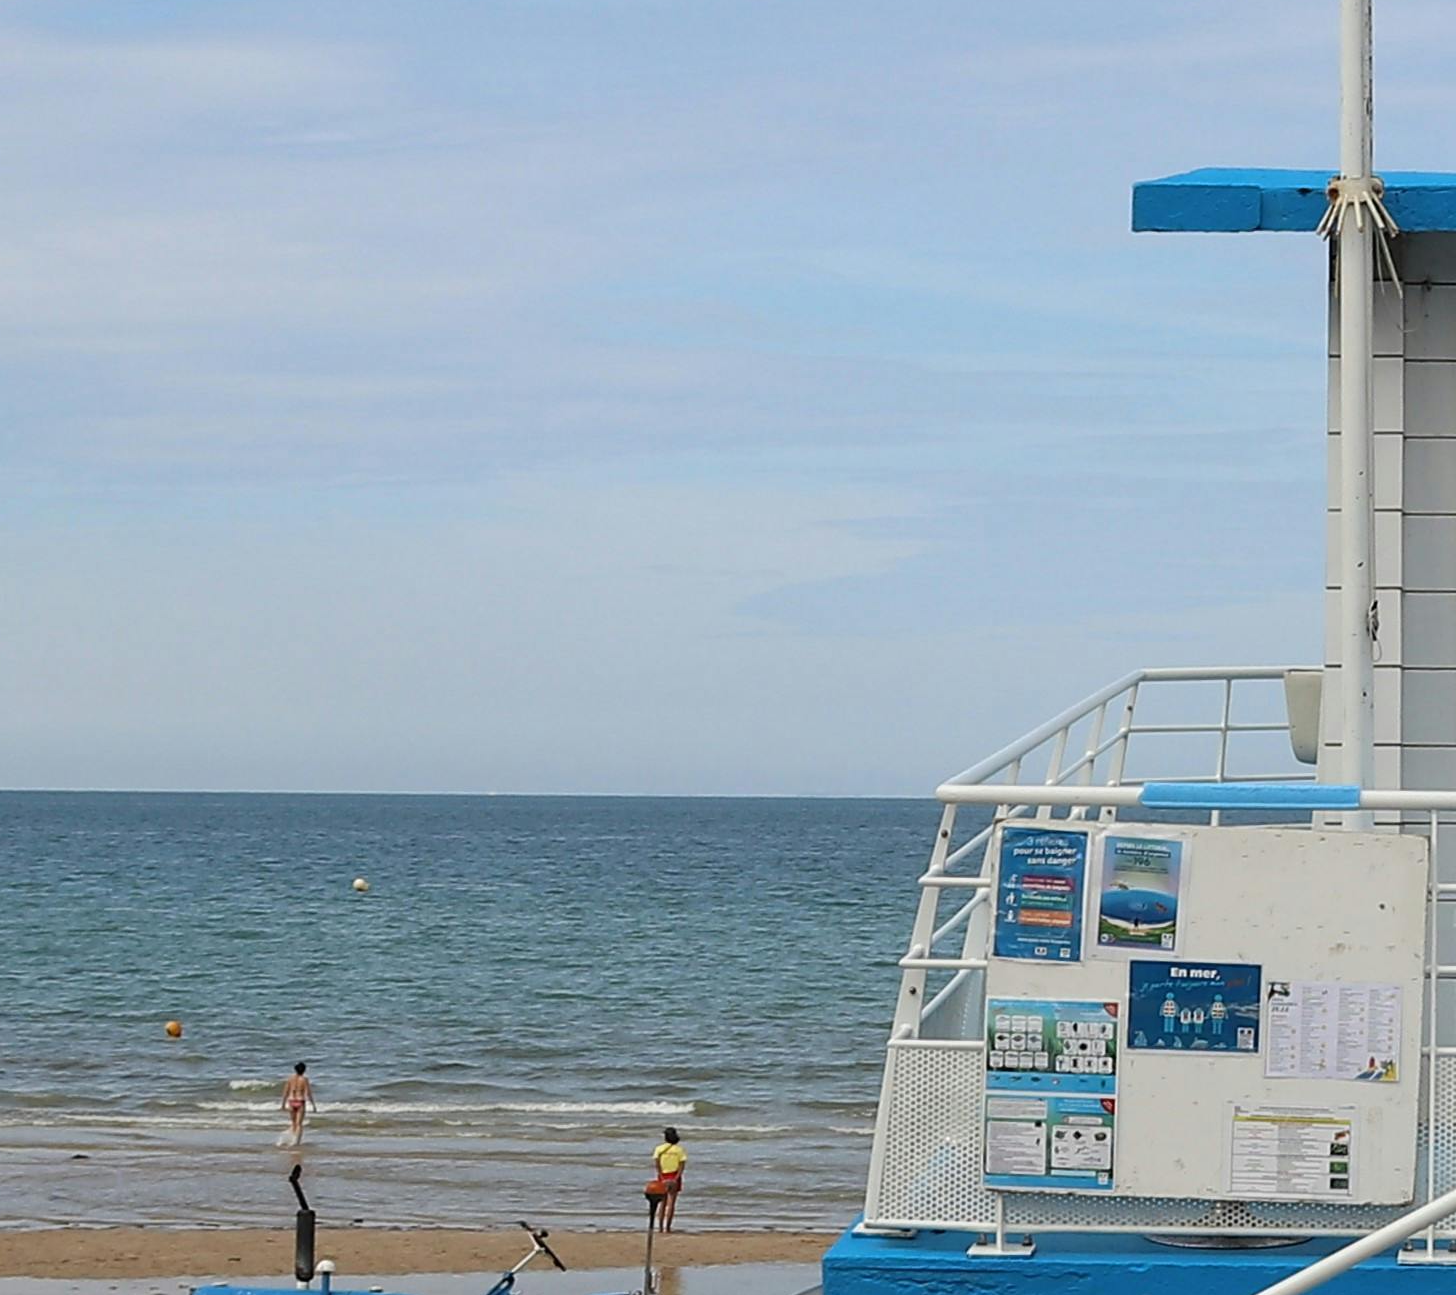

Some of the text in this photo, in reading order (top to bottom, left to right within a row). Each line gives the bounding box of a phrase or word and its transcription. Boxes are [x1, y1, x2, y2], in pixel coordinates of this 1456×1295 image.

[1013, 848, 1033, 856] pour
[1045, 848, 1077, 856] baigner
[1047, 857, 1077, 866] danger
[1170, 967, 1221, 981] En mer,
